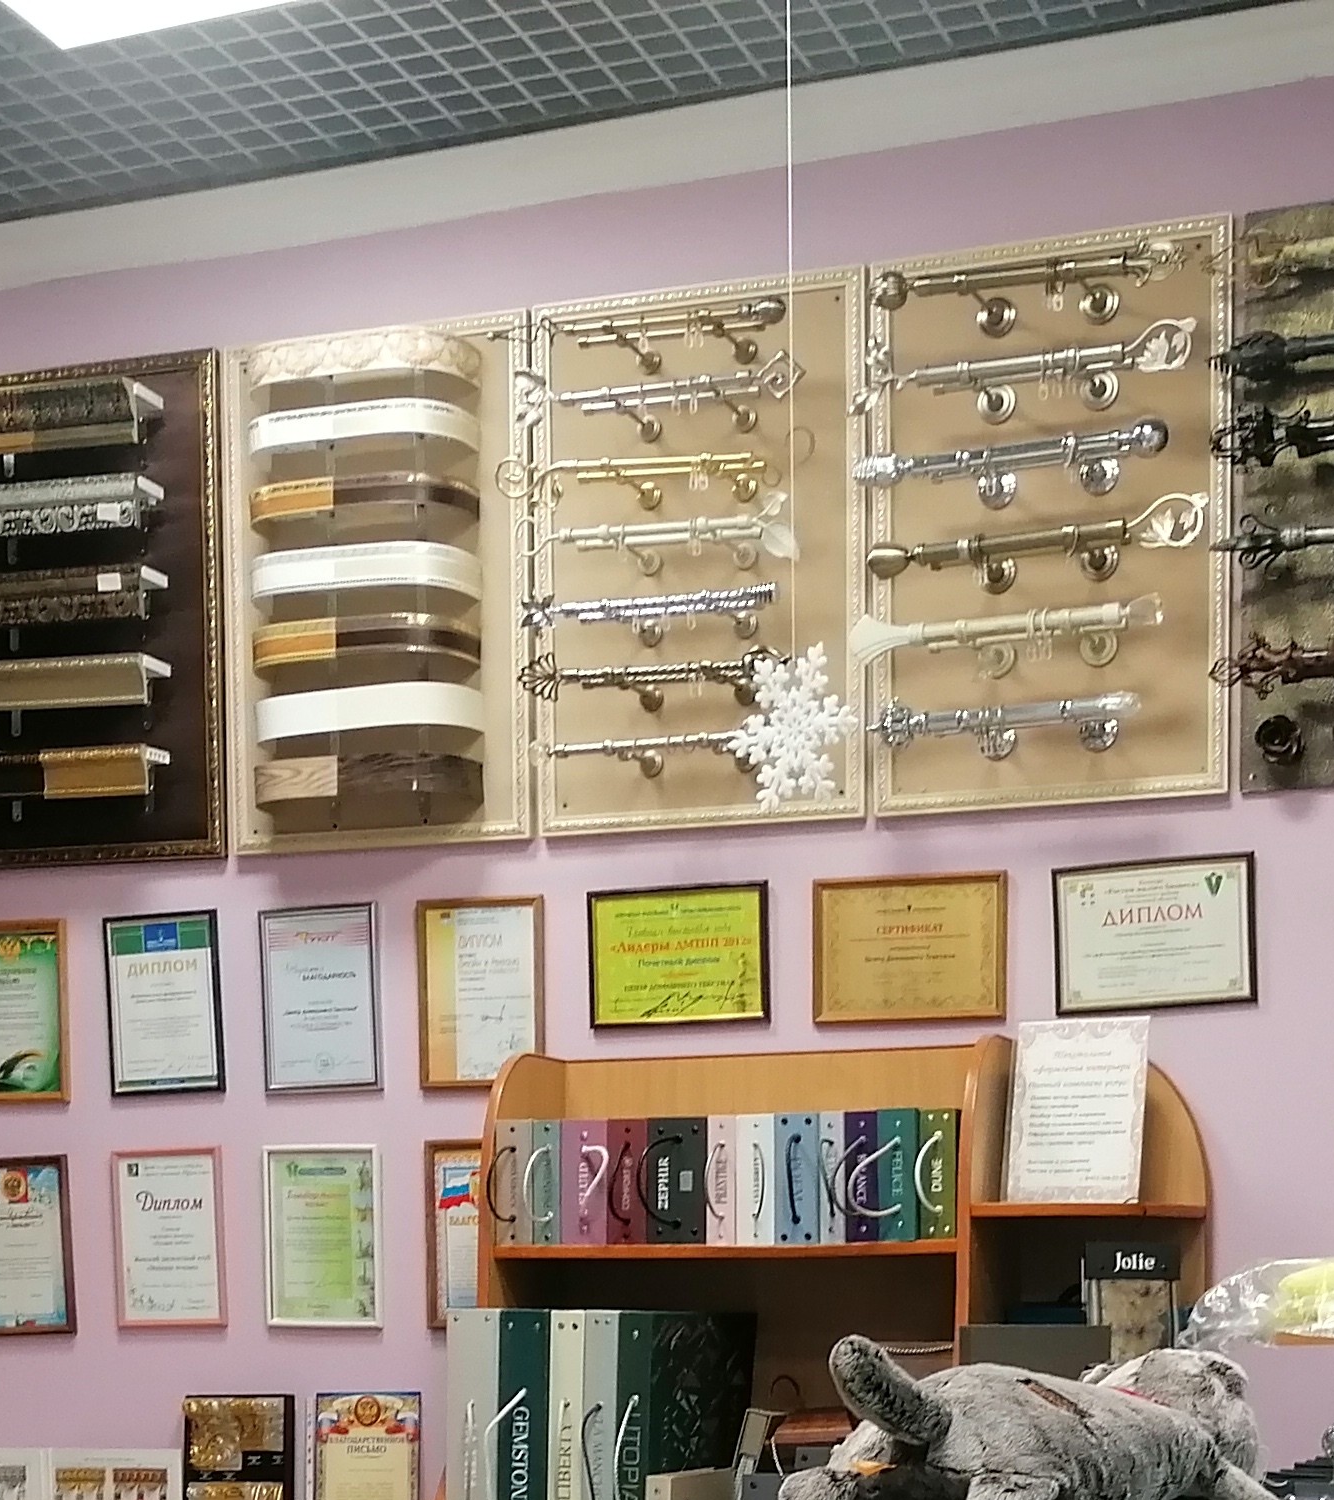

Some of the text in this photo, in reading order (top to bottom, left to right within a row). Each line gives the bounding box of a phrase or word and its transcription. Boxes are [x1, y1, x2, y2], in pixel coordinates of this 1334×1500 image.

[1101, 903, 1203, 927] ДИПЛОМ
[127, 958, 198, 978] ДИПЛОМ
[656, 1156, 670, 1211] ZEPHIR
[891, 1151, 904, 1198] FELICE
[931, 1159, 943, 1193] DUNE
[136, 1190, 203, 1211] Диплом
[1113, 1251, 1156, 1273] Jolie
[557, 1424, 572, 1500] LIBERTY
